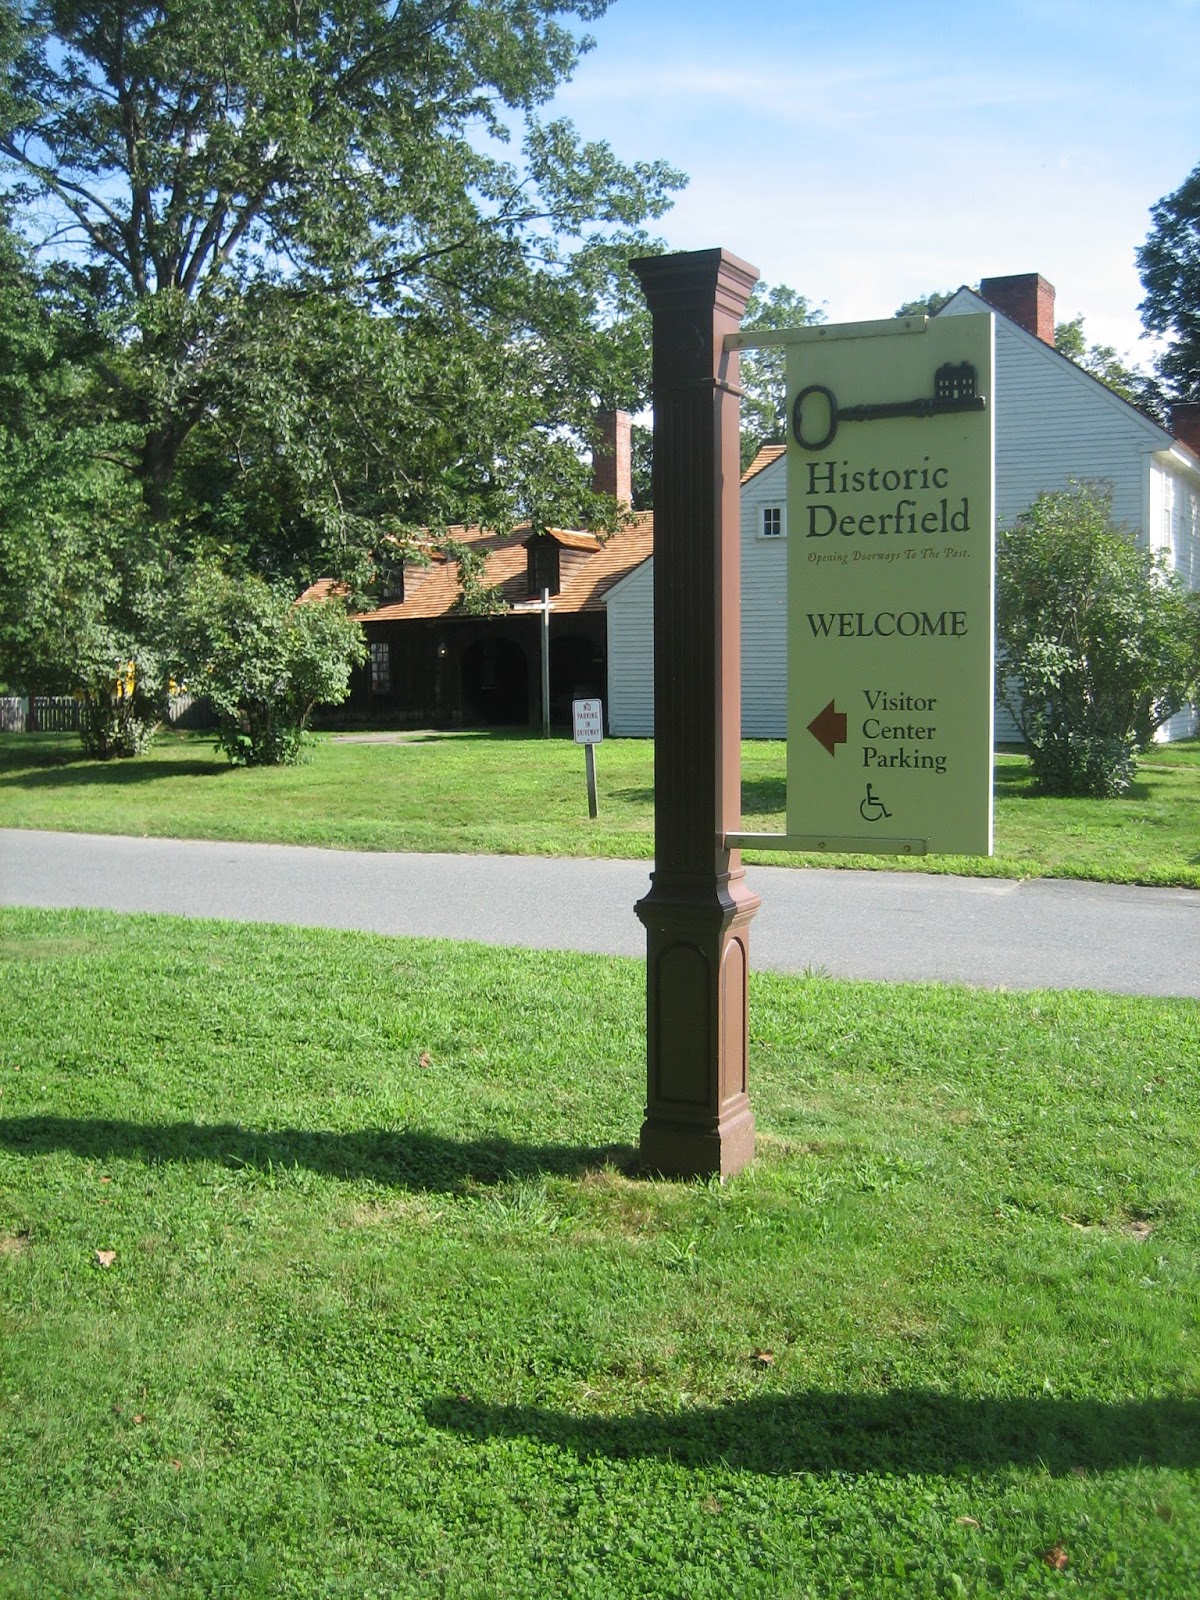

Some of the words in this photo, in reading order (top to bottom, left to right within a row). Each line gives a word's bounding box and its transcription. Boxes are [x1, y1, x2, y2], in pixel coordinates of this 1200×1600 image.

[806, 456, 948, 494] Historic
[806, 498, 970, 538] Deerfield
[807, 551, 848, 565] Opening
[852, 550, 900, 563] Doorways
[904, 549, 917, 560] To
[920, 548, 940, 559] The
[943, 547, 970, 559] Past.
[807, 611, 968, 637] WELCOME
[583, 702, 592, 711] NO
[863, 690, 937, 711] Visitor
[577, 729, 599, 737] DRIVEWAY
[862, 718, 936, 740] Center
[862, 746, 947, 774] Parking
